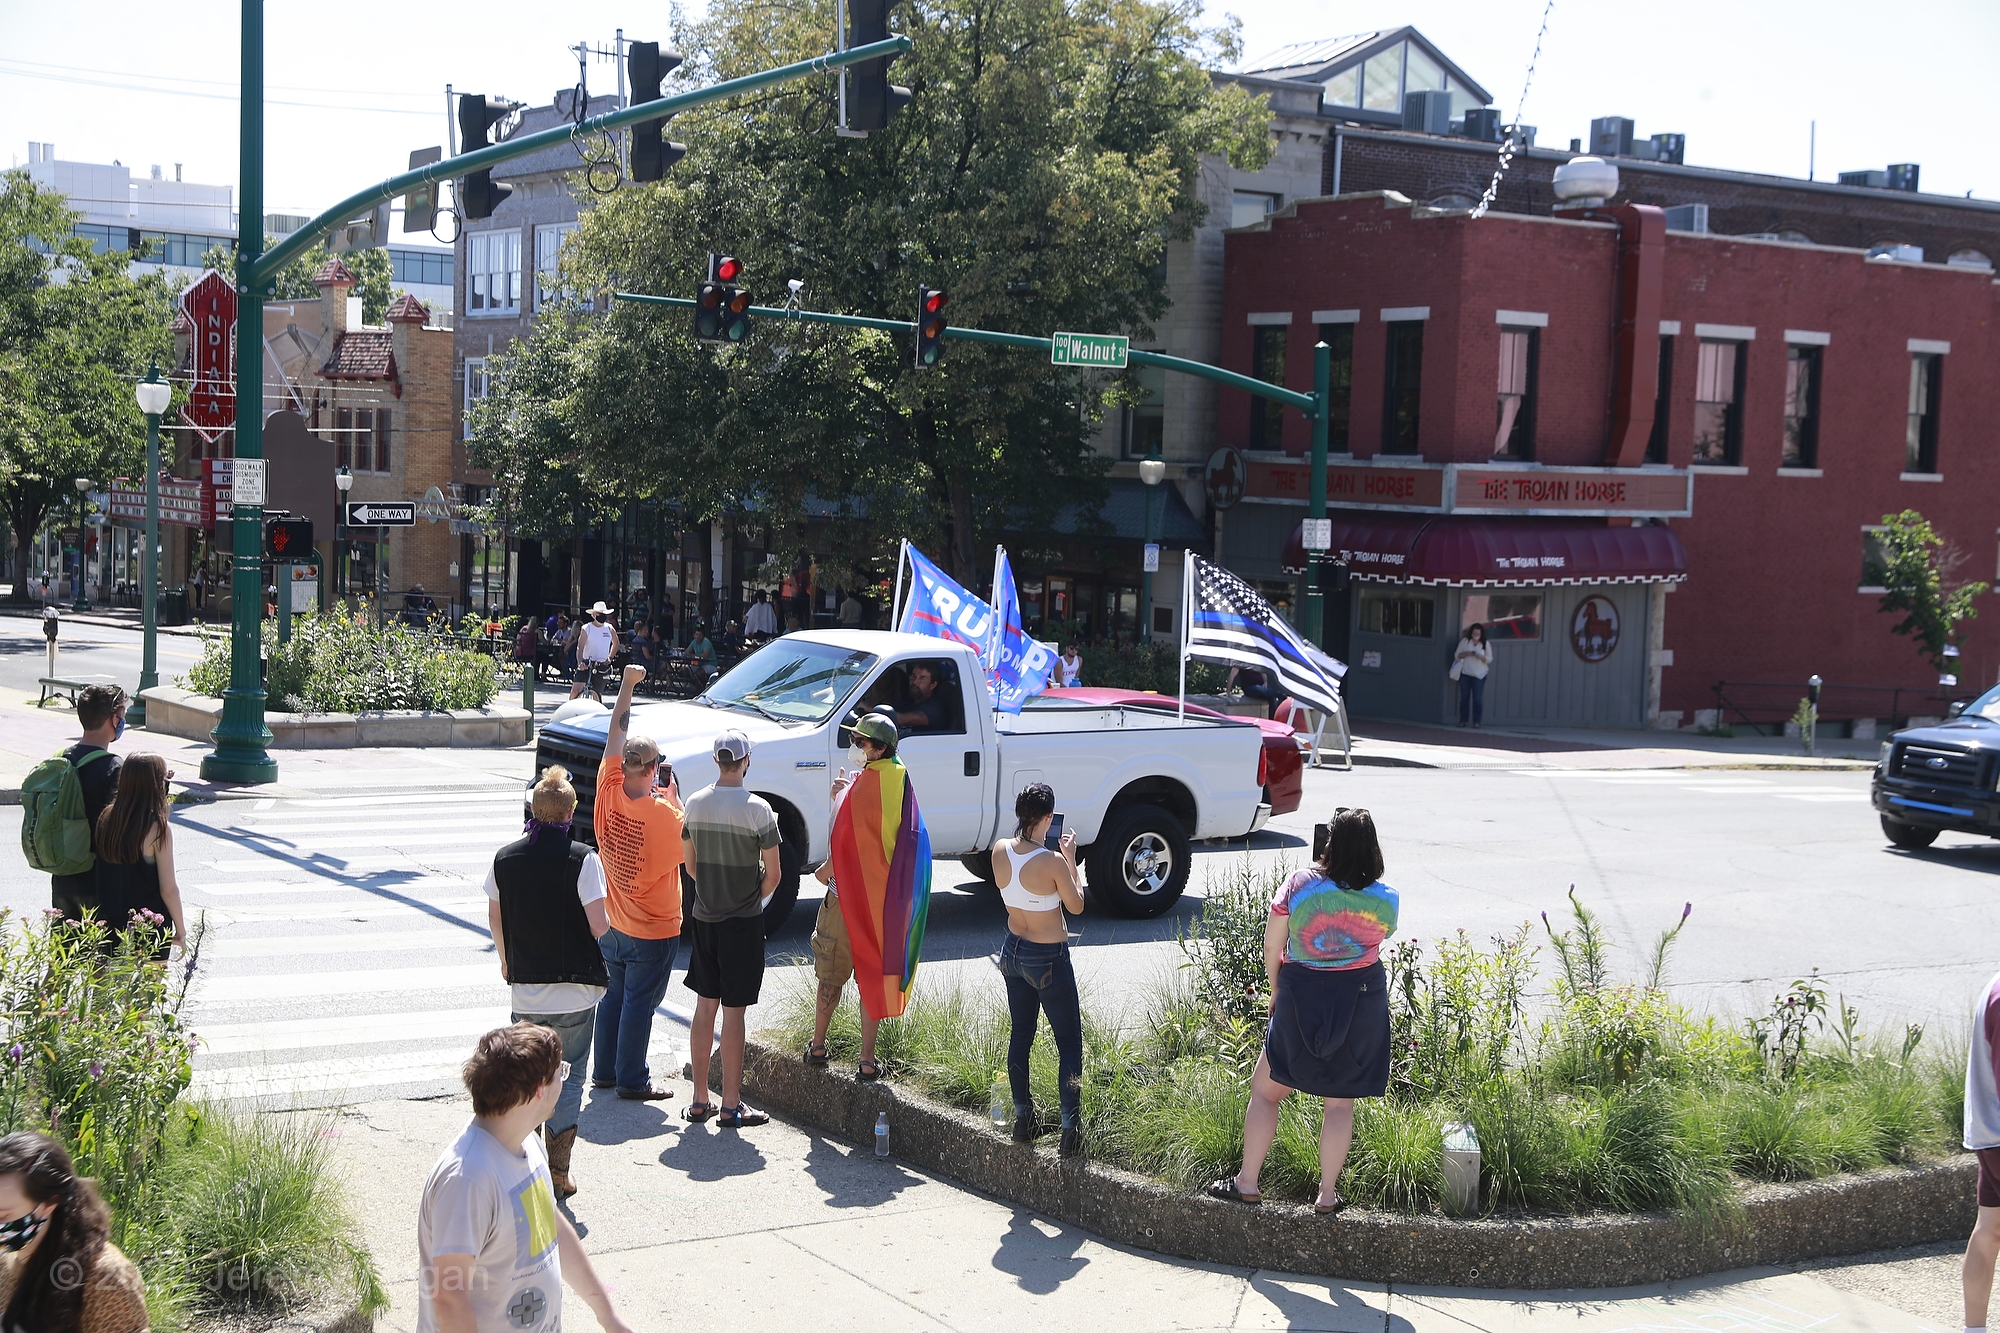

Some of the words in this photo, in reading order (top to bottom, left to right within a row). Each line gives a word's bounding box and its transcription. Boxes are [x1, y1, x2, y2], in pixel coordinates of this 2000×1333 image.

[1056, 337, 1068, 348] 100
[208, 298, 220, 414] INDIANA
[1058, 350, 1064, 360] N
[1072, 340, 1116, 361] Walnut
[1118, 347, 1125, 358] St
[236, 462, 262, 470] SIDEWALK
[1271, 471, 1296, 490] THE
[1302, 472, 1355, 494] TJAN
[1364, 475, 1415, 498] HORSE
[1477, 479, 1508, 499] THE
[1512, 479, 1569, 502] TROJAN
[1576, 480, 1625, 503] HORSE
[368, 510, 385, 519] ONE
[388, 510, 408, 519] WAY
[1354, 551, 1379, 562] TROJAN
[1381, 554, 1405, 564] HORSE
